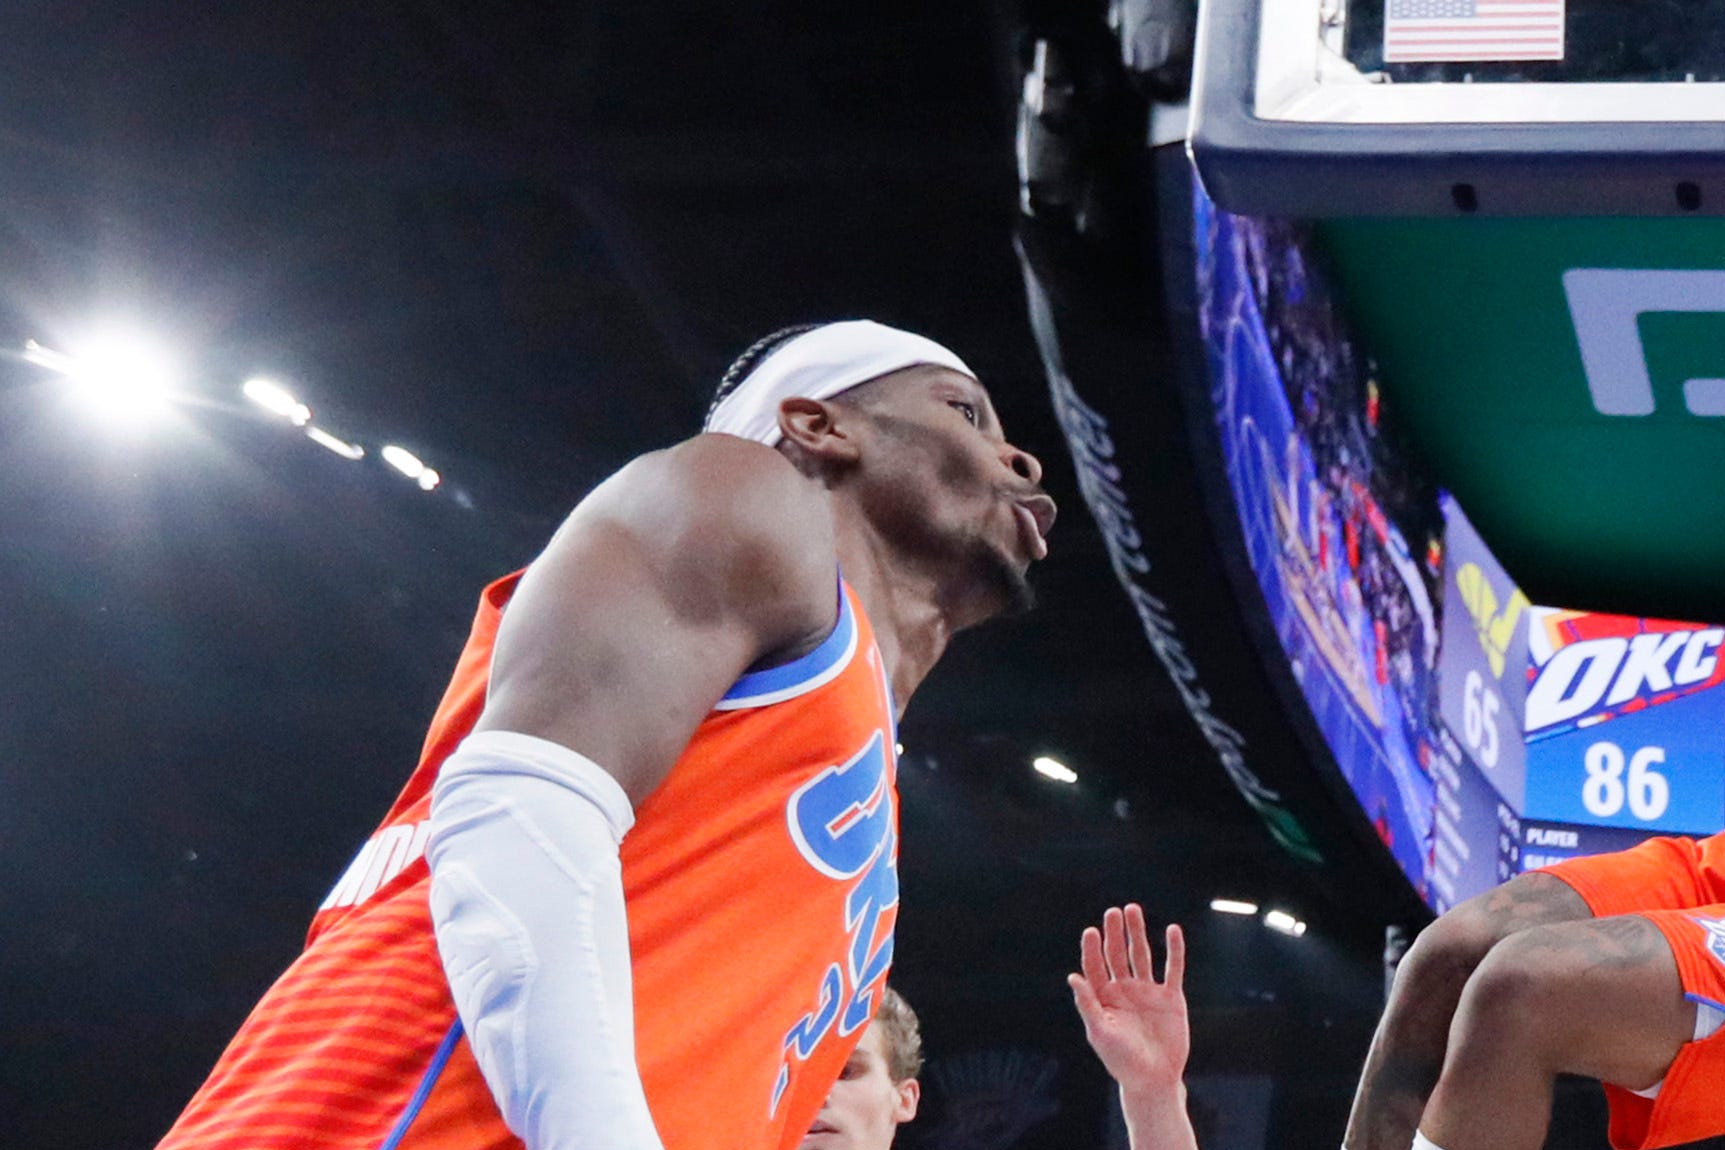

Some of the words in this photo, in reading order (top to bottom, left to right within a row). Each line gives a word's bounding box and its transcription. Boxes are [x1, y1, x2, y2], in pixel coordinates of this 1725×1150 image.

[1463, 669, 1499, 769] 65
[1582, 742, 1669, 821] 86
[1526, 828, 1579, 849] PLAYER
